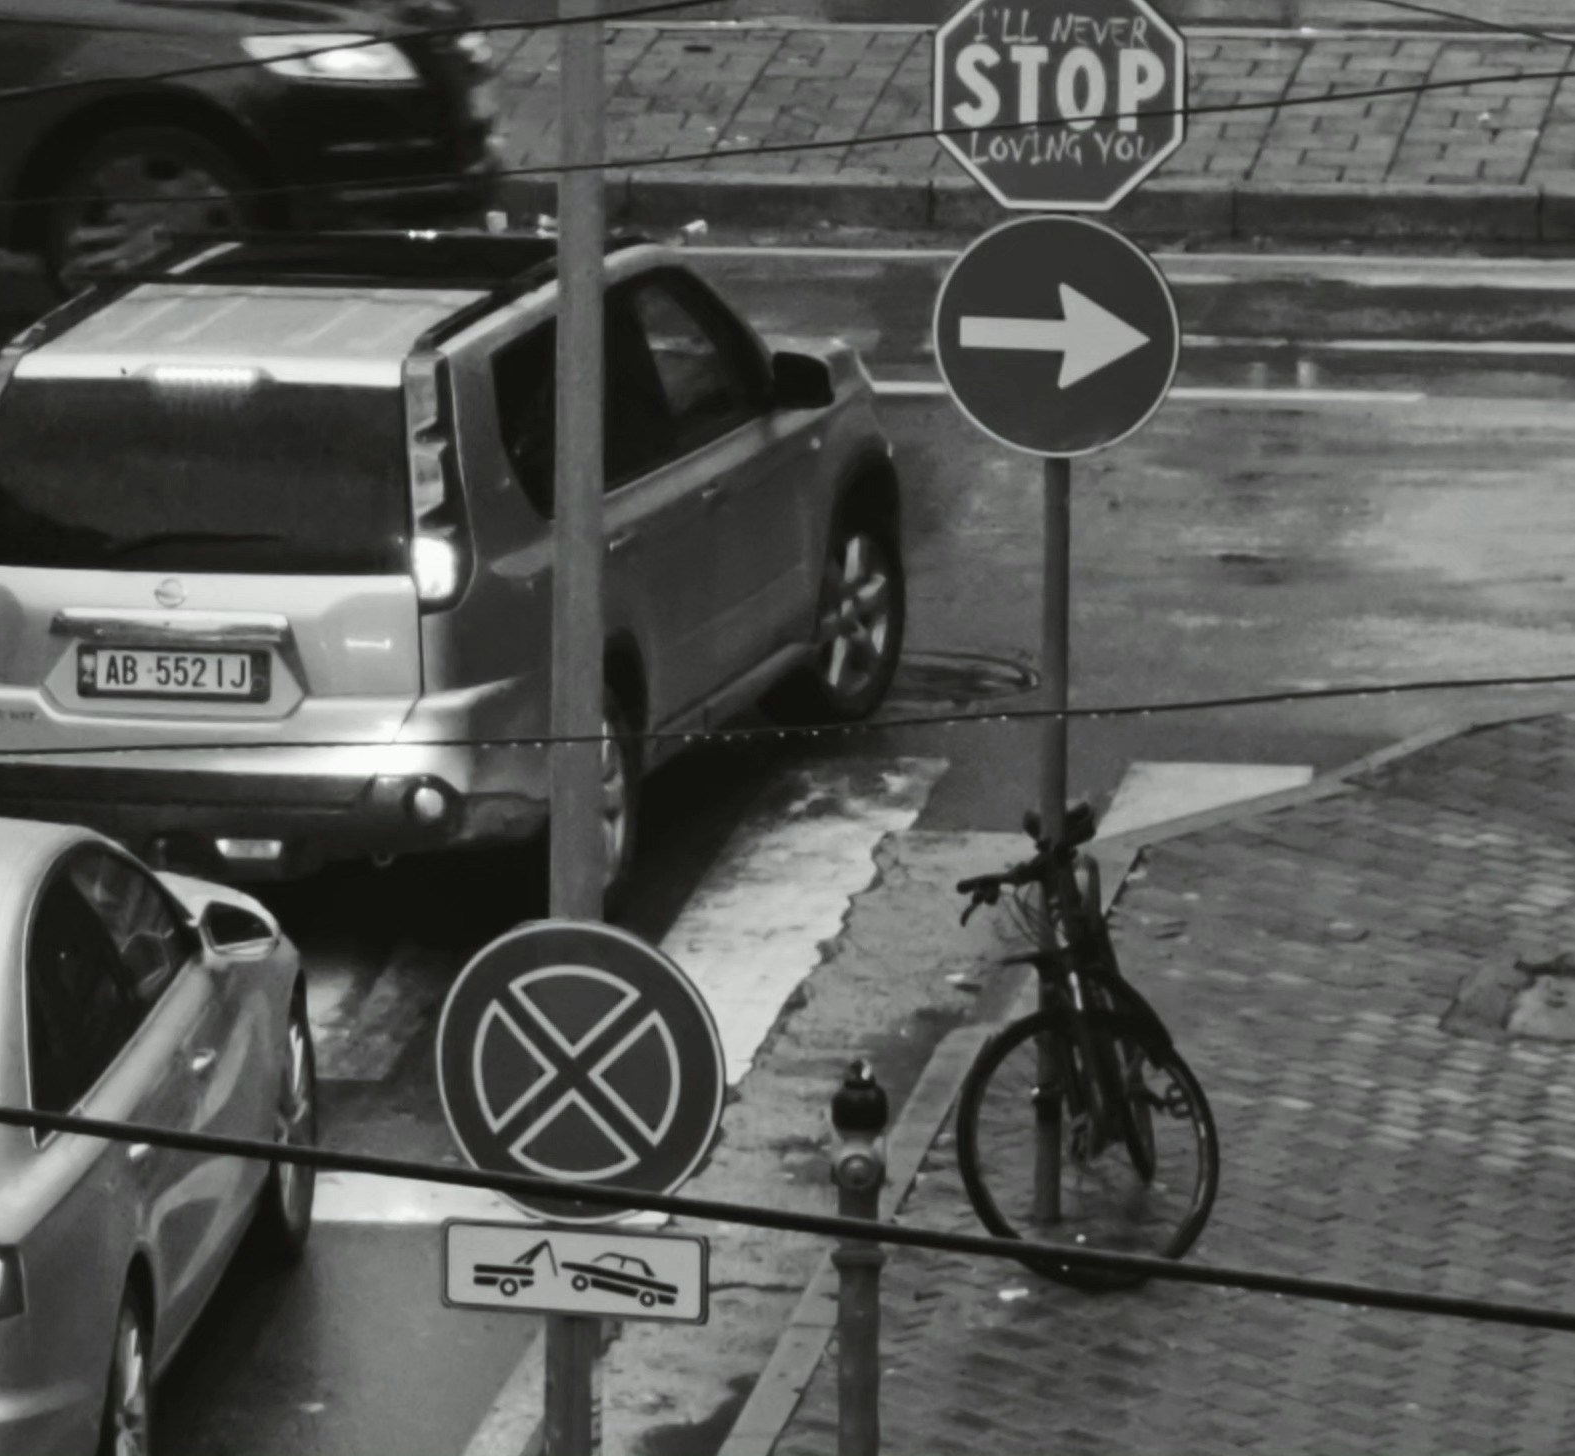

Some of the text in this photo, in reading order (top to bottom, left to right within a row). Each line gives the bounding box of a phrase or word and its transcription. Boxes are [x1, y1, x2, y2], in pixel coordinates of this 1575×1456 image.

[970, 8, 1149, 48] I'LL NEVER
[952, 45, 1167, 133] STOP
[970, 130, 1153, 166] LOVING YOU
[106, 654, 247, 689] AB 552IJ
